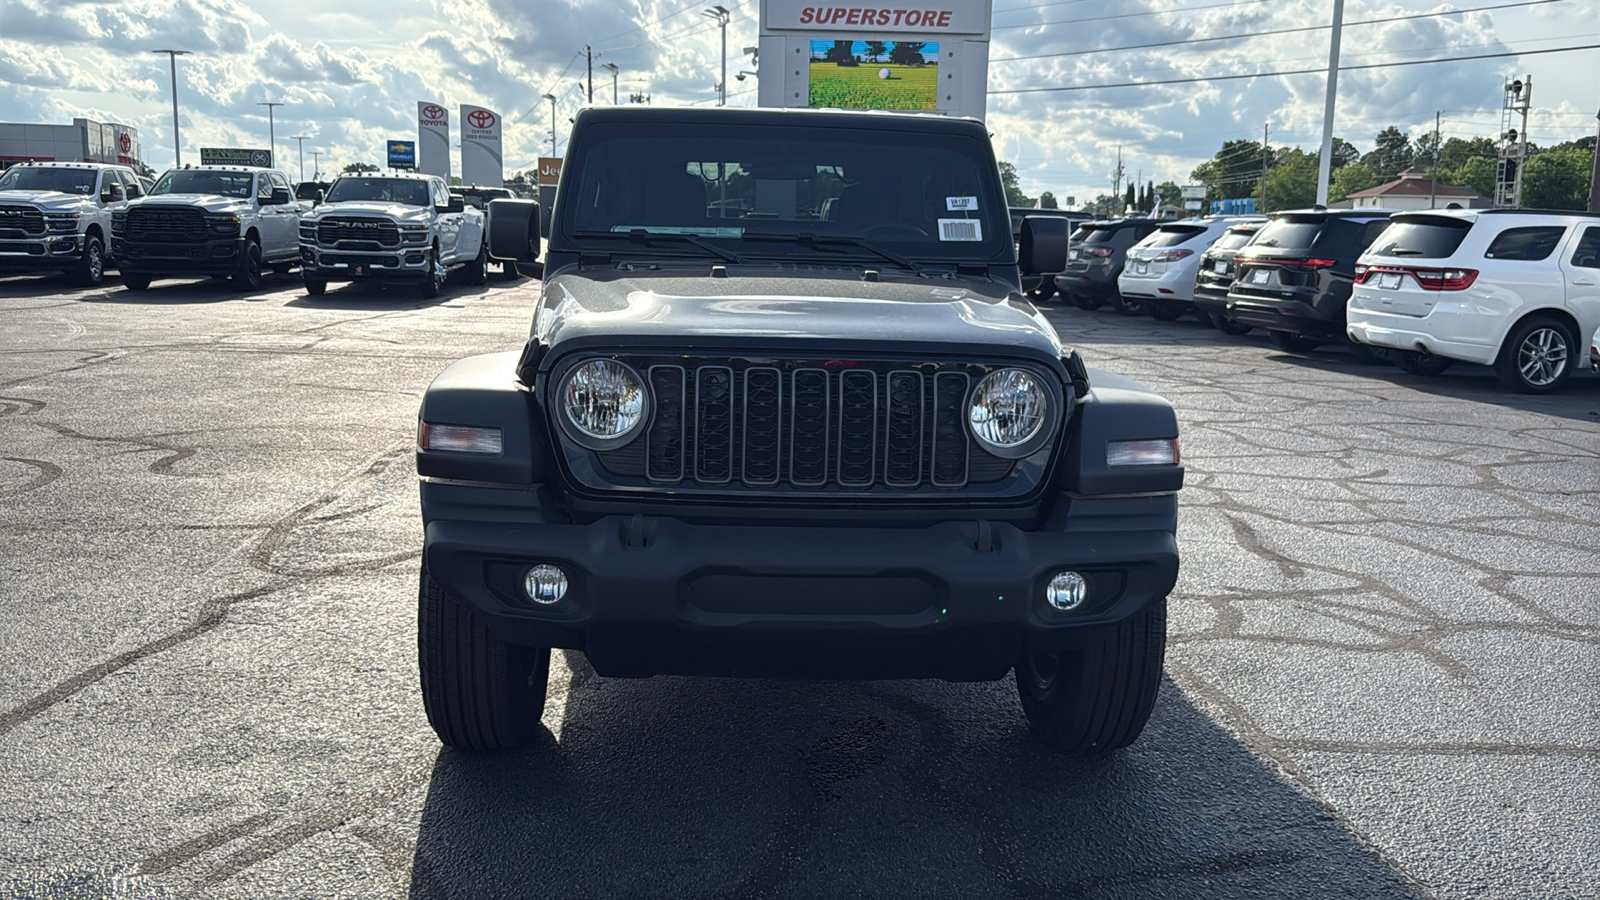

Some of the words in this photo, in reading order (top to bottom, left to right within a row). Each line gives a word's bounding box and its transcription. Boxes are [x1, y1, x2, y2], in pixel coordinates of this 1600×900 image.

[800, 7, 953, 27] SUPERSTORE
[541, 164, 561, 176] Je
[338, 221, 378, 229] RAM
